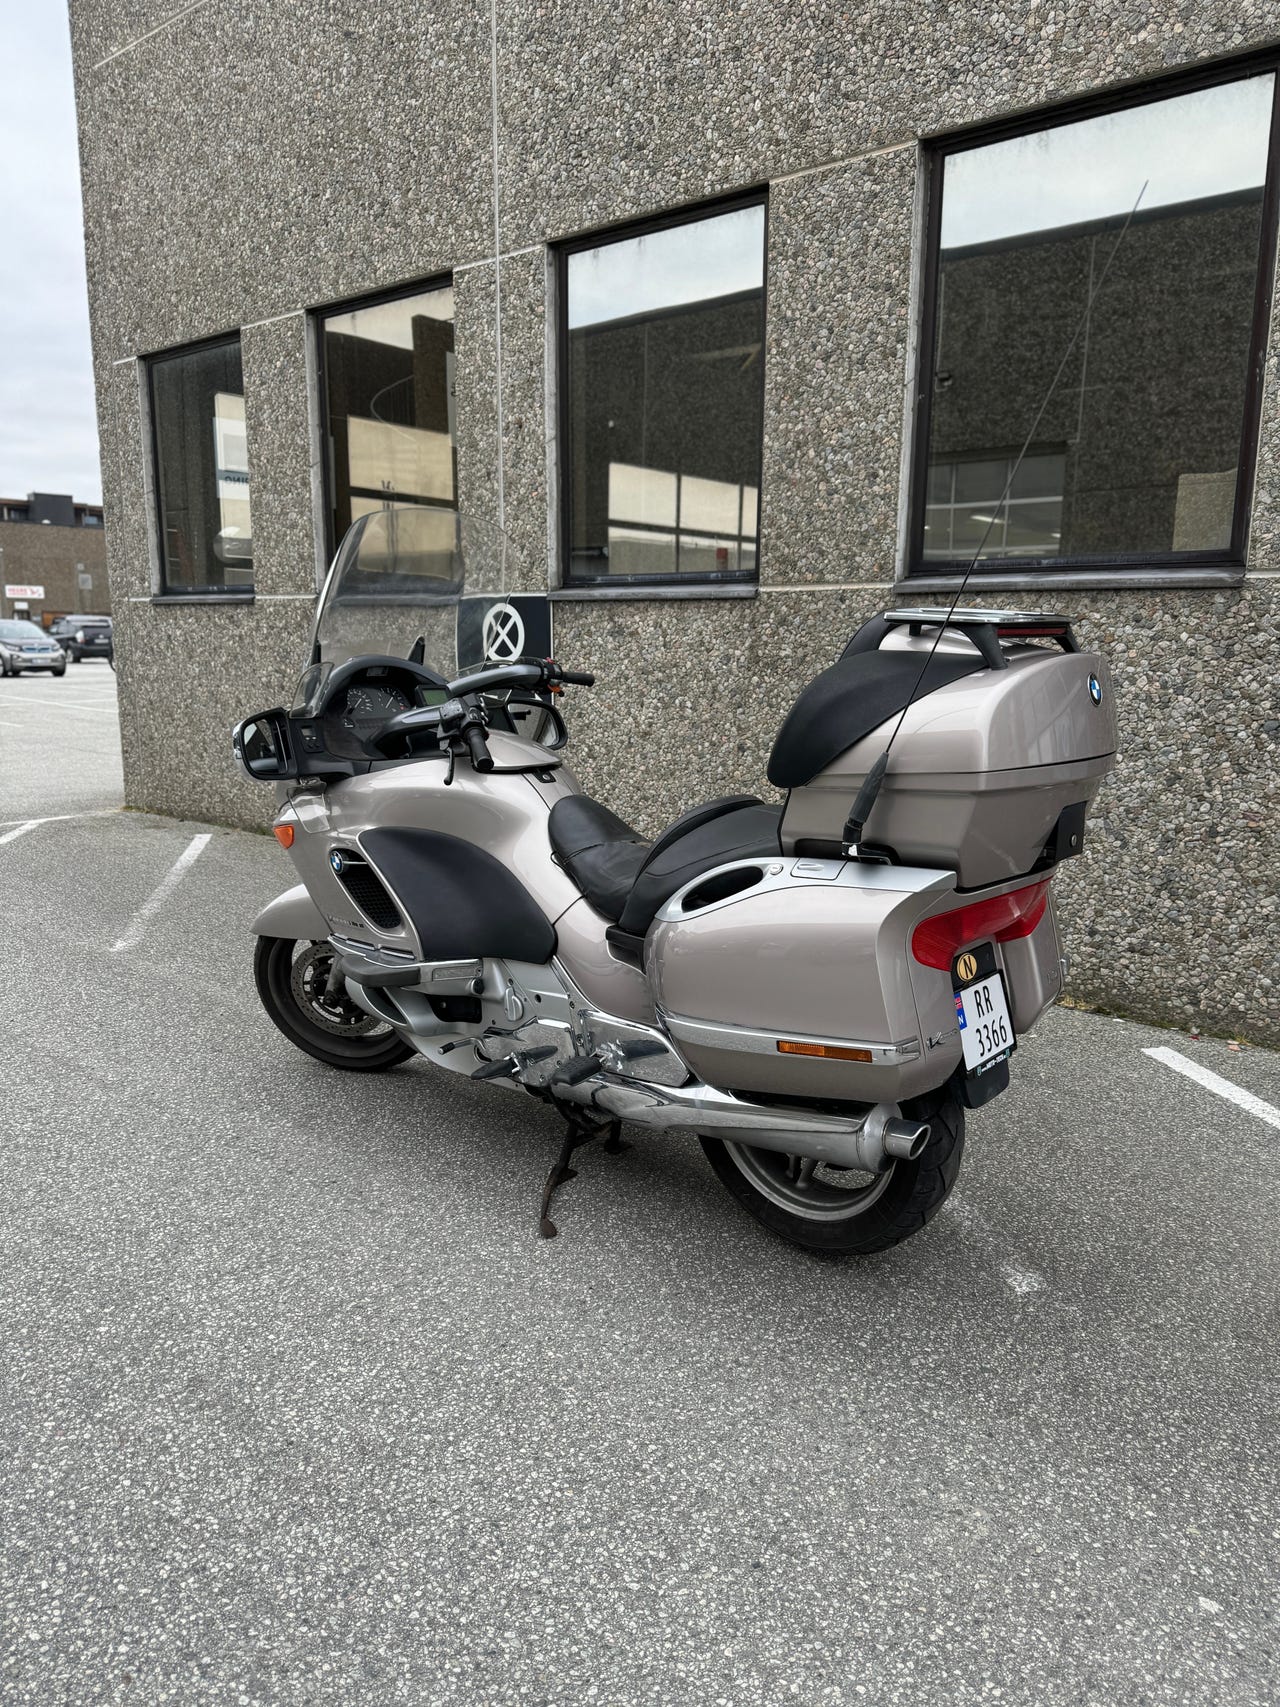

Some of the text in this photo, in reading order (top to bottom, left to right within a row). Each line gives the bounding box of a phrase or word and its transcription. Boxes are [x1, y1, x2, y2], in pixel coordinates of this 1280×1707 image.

[963, 955, 974, 979] N
[974, 985, 993, 1018] RR
[958, 1015, 964, 1025] N
[976, 1015, 1007, 1057] 3366
